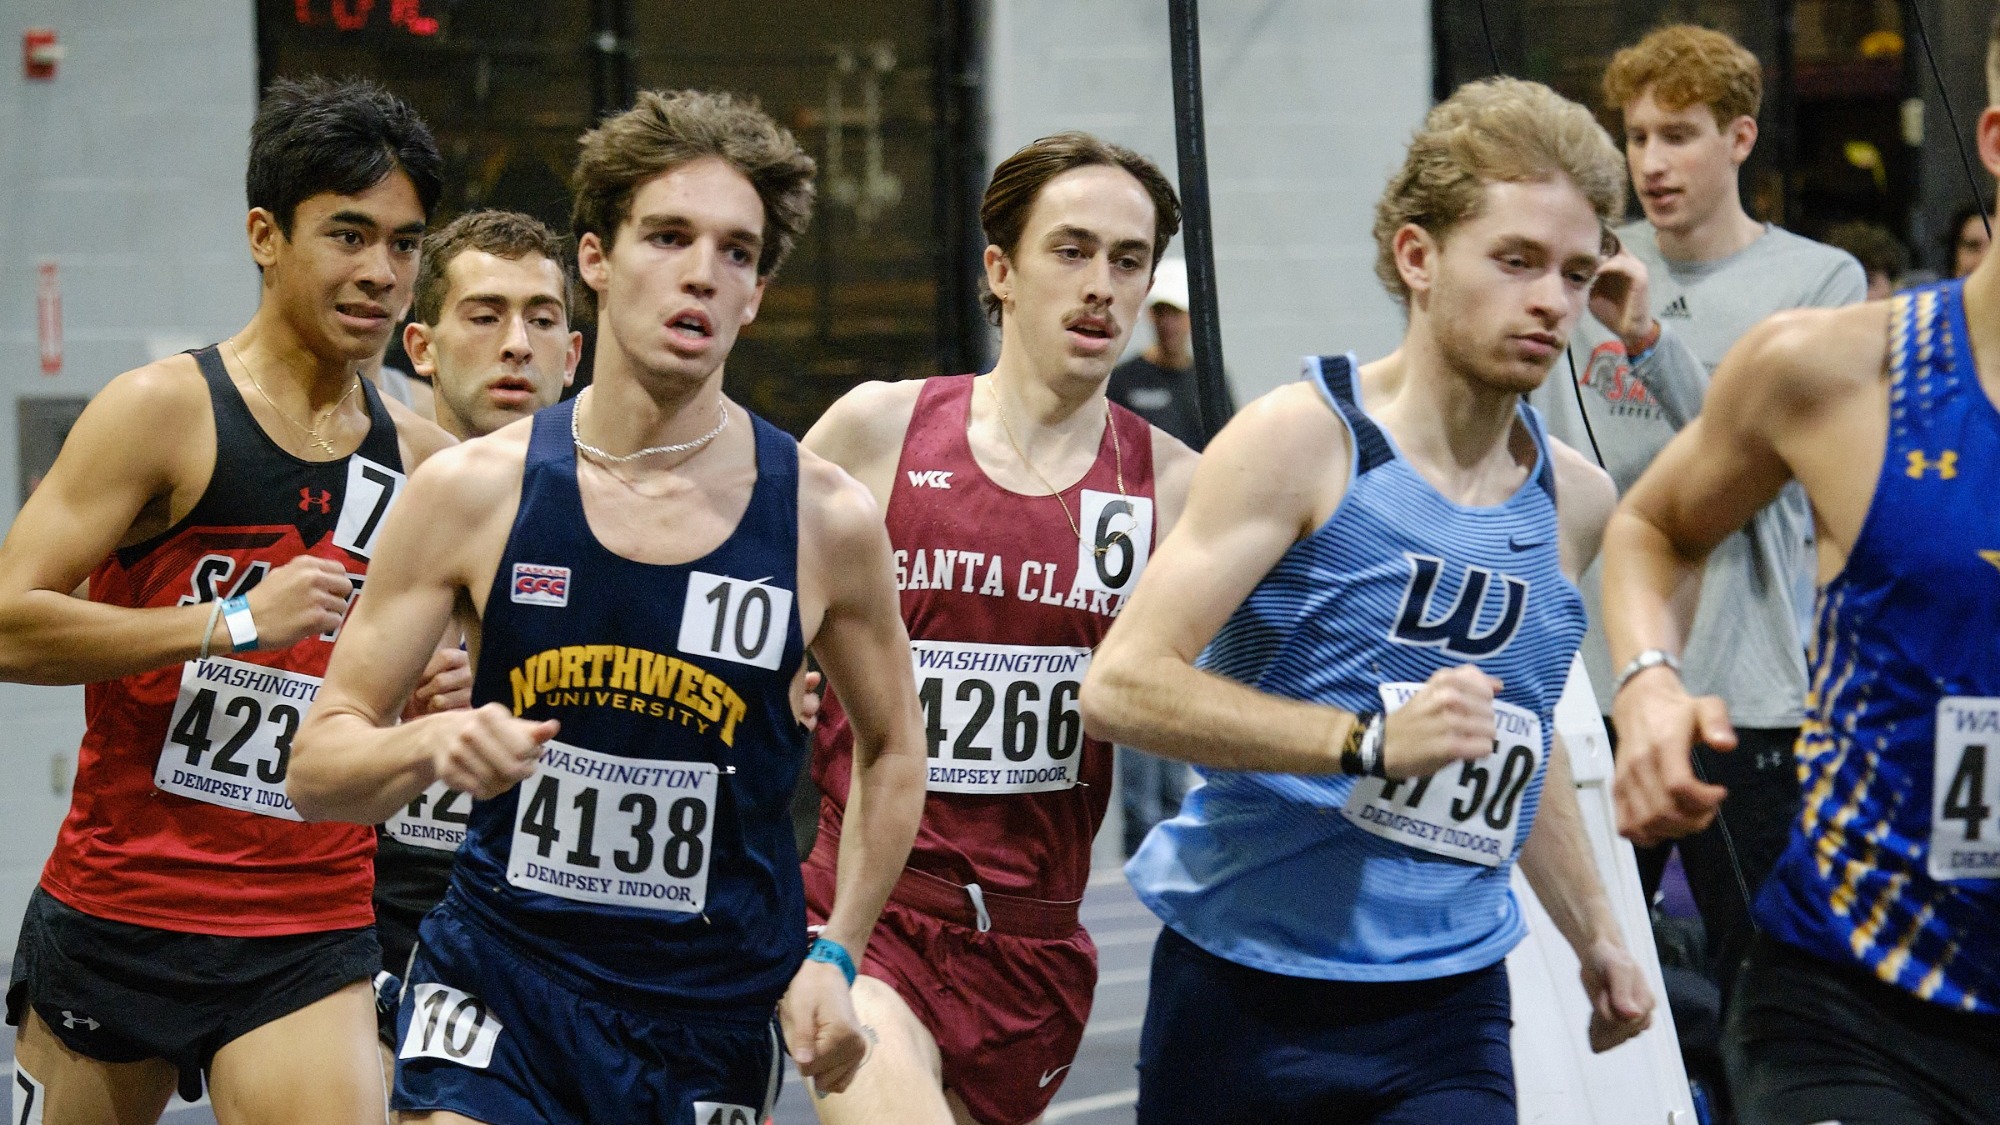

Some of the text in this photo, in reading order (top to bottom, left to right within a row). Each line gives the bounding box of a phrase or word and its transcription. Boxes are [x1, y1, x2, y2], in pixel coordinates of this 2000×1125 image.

[908, 470, 954, 488] WCC
[352, 465, 396, 550] 7
[1095, 500, 1134, 589] 6
[516, 576, 566, 596] CCC
[705, 582, 771, 660] 10
[920, 650, 1079, 673] WASHINGTON
[509, 645, 747, 748] NORTHWEST
[545, 692, 710, 735] UNIVERSITY
[919, 678, 1081, 762] 4266
[171, 769, 253, 801] DEMPSEY
[539, 749, 706, 790] WASHINGTON
[928, 766, 1067, 785] EMPSEY INDOOR
[520, 775, 708, 880] 4138
[1360, 804, 1503, 856] DEMPSEY INDOOR
[526, 863, 692, 902] DEMPSEY INDOOR
[422, 990, 484, 1059] 10
